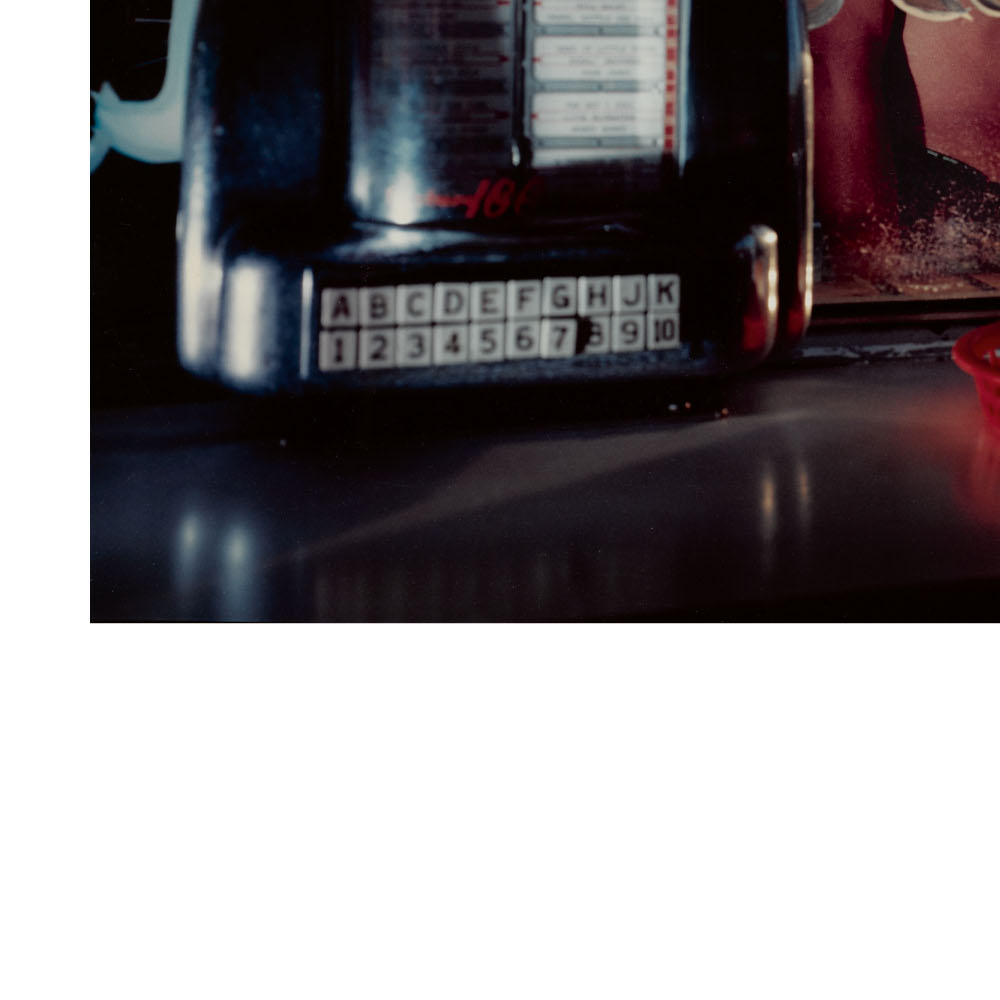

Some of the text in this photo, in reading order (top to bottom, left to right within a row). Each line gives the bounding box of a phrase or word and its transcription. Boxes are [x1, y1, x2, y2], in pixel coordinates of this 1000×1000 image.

[331, 281, 675, 321] A B C D E F G H J K
[334, 339, 344, 363] 1
[371, 337, 387, 361] 2
[408, 334, 424, 358] 3
[445, 332, 460, 355] 4
[481, 329, 497, 353] 5
[516, 327, 533, 350] 6
[554, 326, 568, 349] 7
[622, 321, 637, 343] 9
[655, 320, 675, 342] 10
